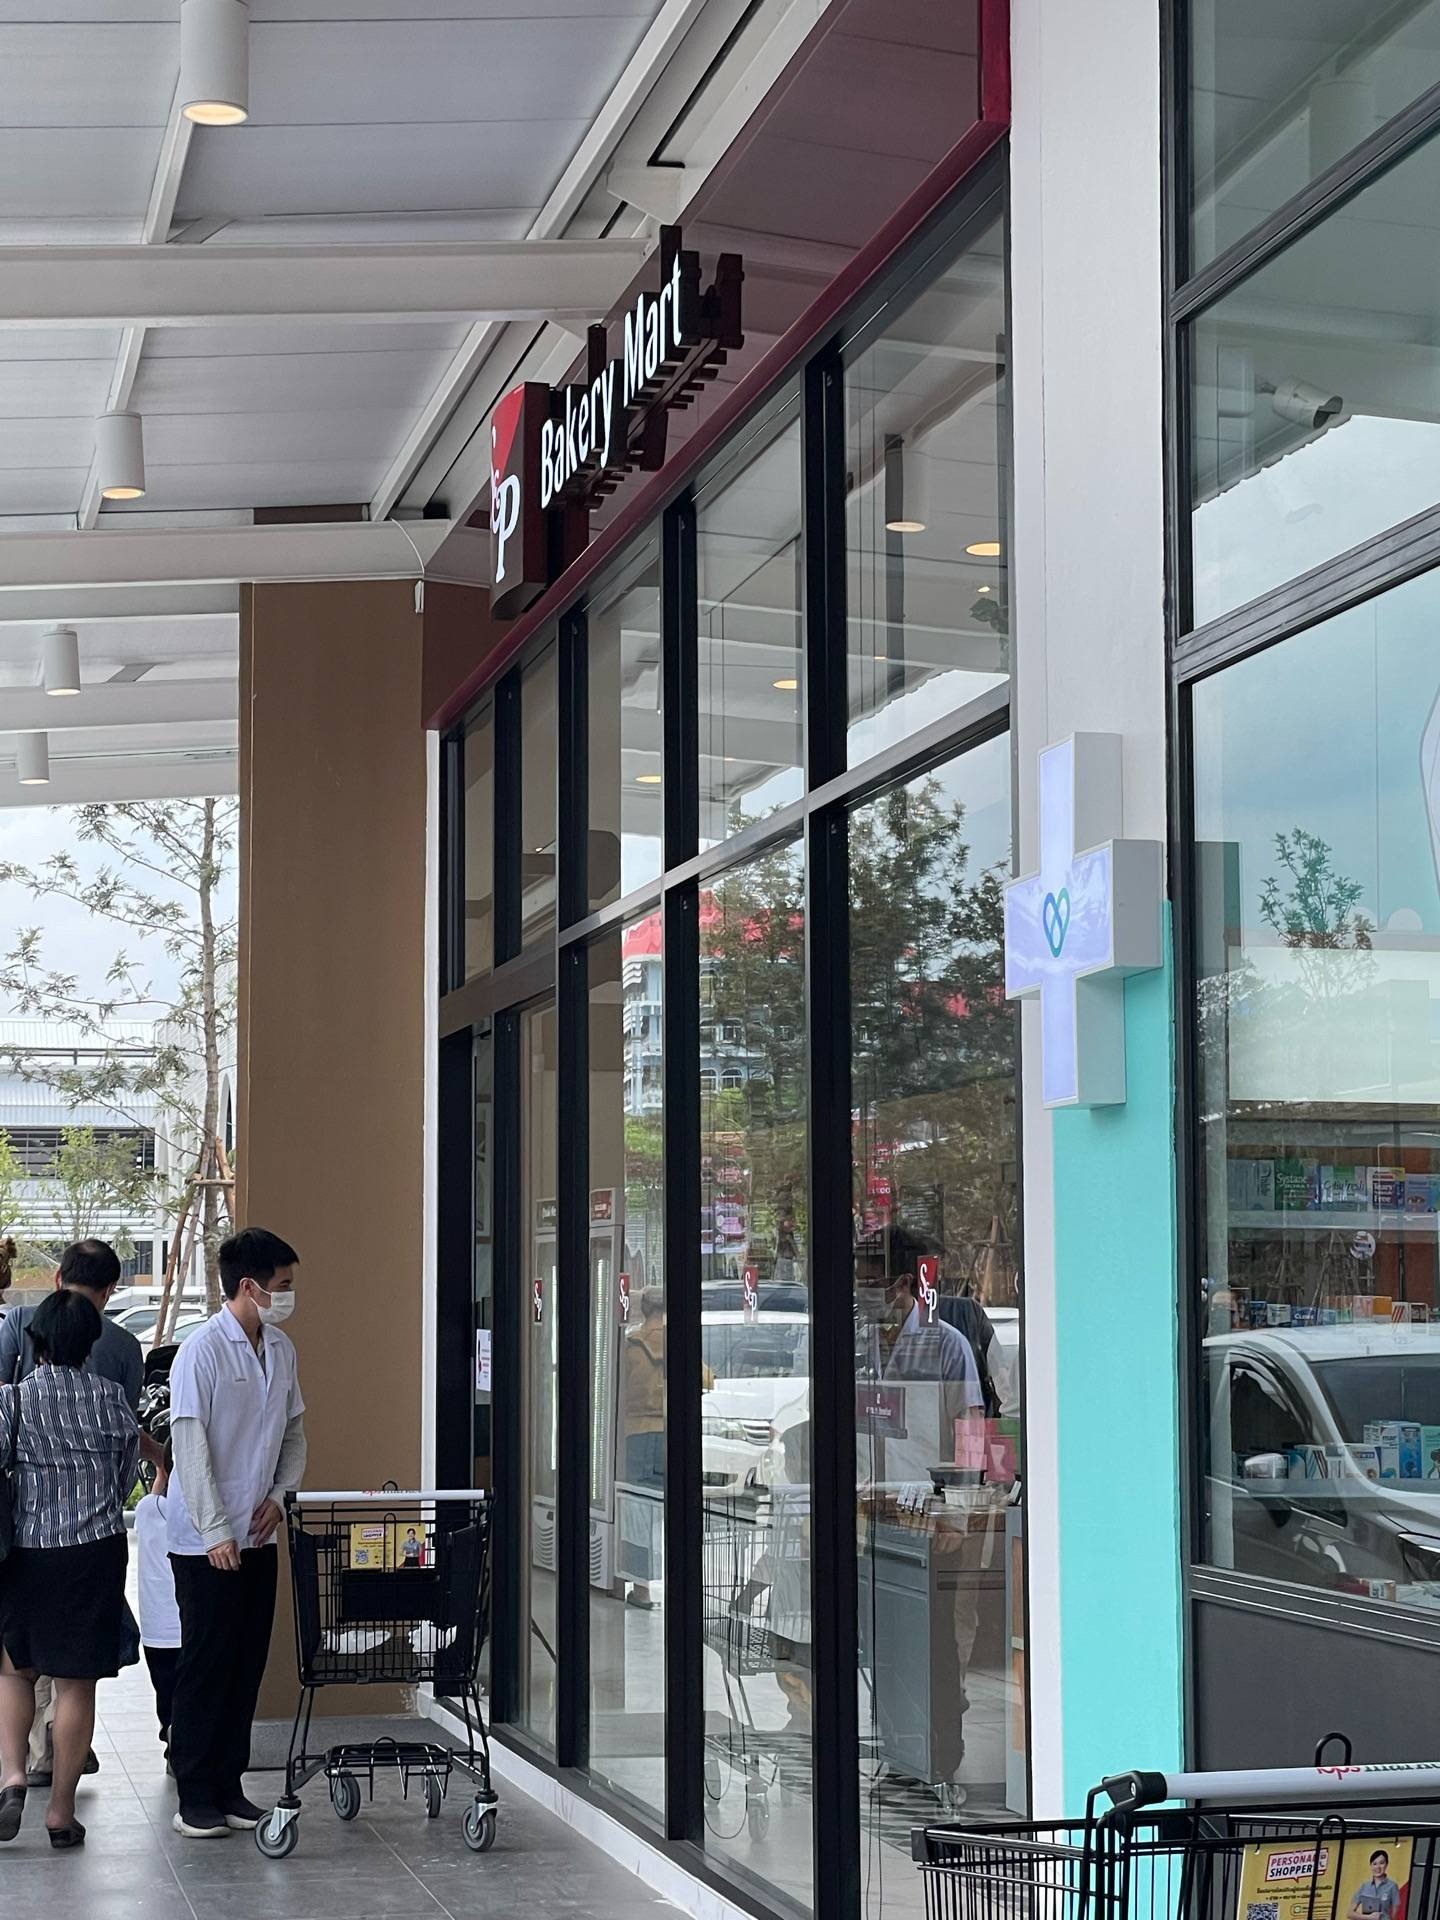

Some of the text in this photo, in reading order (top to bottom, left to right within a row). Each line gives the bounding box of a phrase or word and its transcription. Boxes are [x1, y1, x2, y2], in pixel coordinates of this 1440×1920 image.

[541, 252, 682, 510] Bakery Mart
[1269, 1864, 1313, 1878] SHOPPER
